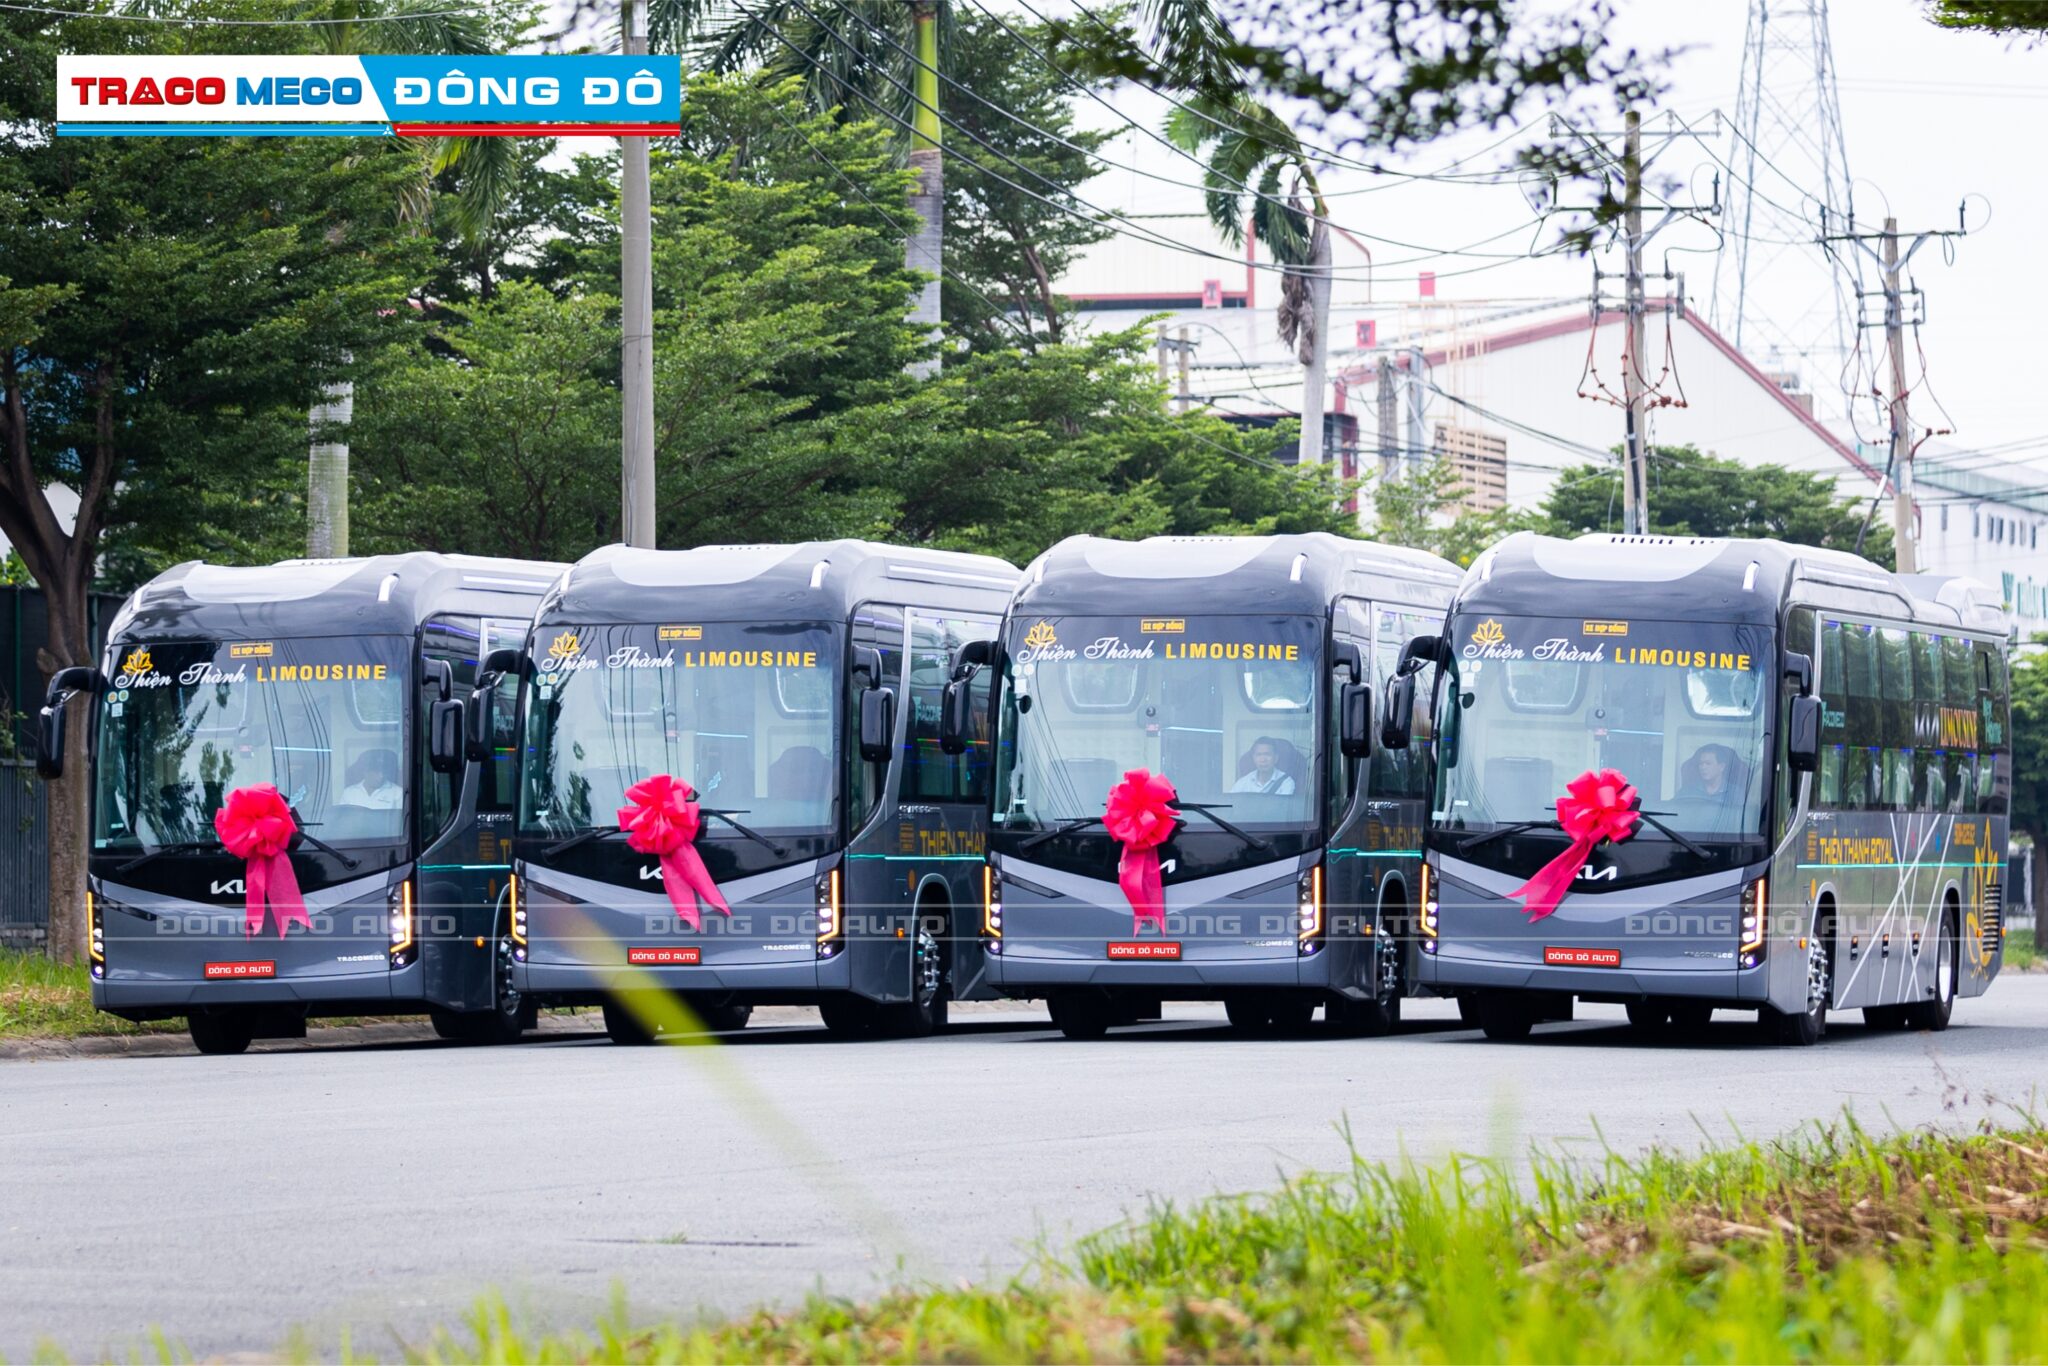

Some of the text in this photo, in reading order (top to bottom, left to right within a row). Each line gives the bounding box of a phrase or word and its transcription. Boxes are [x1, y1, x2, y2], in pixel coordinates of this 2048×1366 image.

[1017, 637, 1298, 664] Thiện Thành LIMOUSINE
[1463, 638, 1750, 670] Thiện Thành LIMOUSINE
[541, 646, 816, 673] Thiện Thành LIMOUSINE
[115, 662, 386, 690] Thiện Thành LIMOUSINE
[1872, 837, 1894, 864] ROYAL
[762, 943, 811, 951] TRACOMECO
[1111, 945, 1177, 954] ĐÔNG ĐÔ AUTO
[336, 954, 385, 962] TRACOMECO
[632, 951, 697, 961] ĐÔNG ĐÔ AUTO
[1548, 951, 1616, 962] ĐÔNG ĐÔ AUTO
[208, 964, 272, 975] ĐÔNG ĐÔ AUTO
